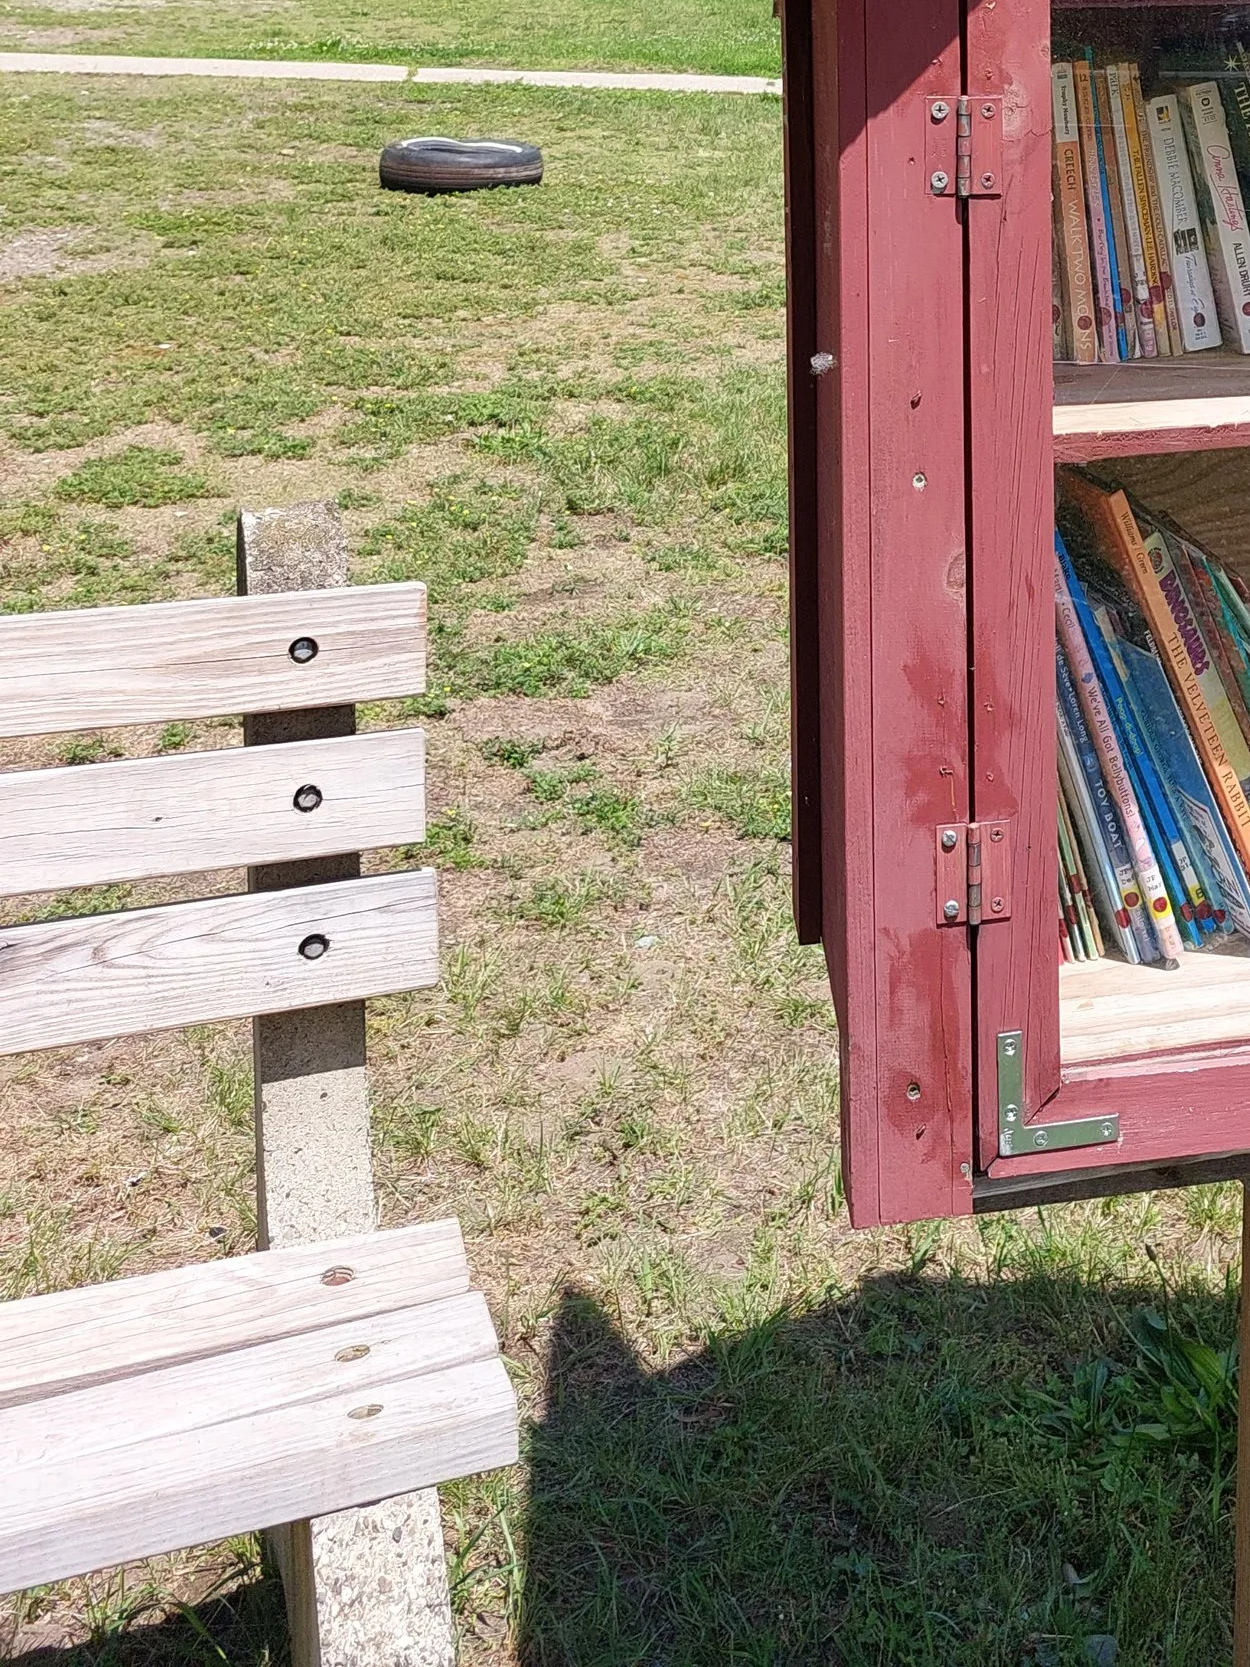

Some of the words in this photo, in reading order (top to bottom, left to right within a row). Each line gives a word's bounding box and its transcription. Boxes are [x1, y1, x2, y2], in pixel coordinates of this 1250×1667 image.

[1062, 107, 1070, 135] Newbery
[1139, 129, 1148, 143] THE
[1063, 148, 1076, 190] CREECH
[1131, 149, 1140, 162] THE
[1142, 143, 1155, 183] FRIENDSHIP
[1163, 137, 1178, 169] DEBBIE
[1205, 141, 1234, 182] Anna
[1133, 162, 1145, 194] FALLEN
[1150, 198, 1159, 212] THE
[1168, 170, 1188, 225] MACOMBER
[1214, 181, 1246, 234] Hastings
[1067, 198, 1082, 244] WALK
[1138, 194, 1151, 235] SPACEMAN
[1153, 212, 1162, 233] GOLD
[1071, 244, 1085, 284] TWO
[1156, 233, 1168, 267] CADILLAC
[1231, 241, 1246, 269] ALLEN
[1075, 288, 1092, 350] MONS
[1121, 511, 1137, 547] Williams
[1136, 553, 1149, 574] Green
[1057, 553, 1072, 581] Blake
[1062, 606, 1075, 629] Cecil
[1159, 569, 1210, 676] DINOSAURS
[1056, 654, 1064, 666] de
[1059, 666, 1072, 687] Sève
[1066, 691, 1082, 718] Loren
[1088, 686, 1101, 716] We've
[1167, 631, 1187, 669] THE
[1183, 672, 1228, 766] VELVETEEN
[1074, 719, 1089, 743] Long
[1096, 719, 1110, 733] All
[1102, 735, 1115, 753] Got
[1109, 756, 1135, 818] Bellybuttons!
[1095, 780, 1110, 807] TOY
[1104, 813, 1124, 848] BOAT
